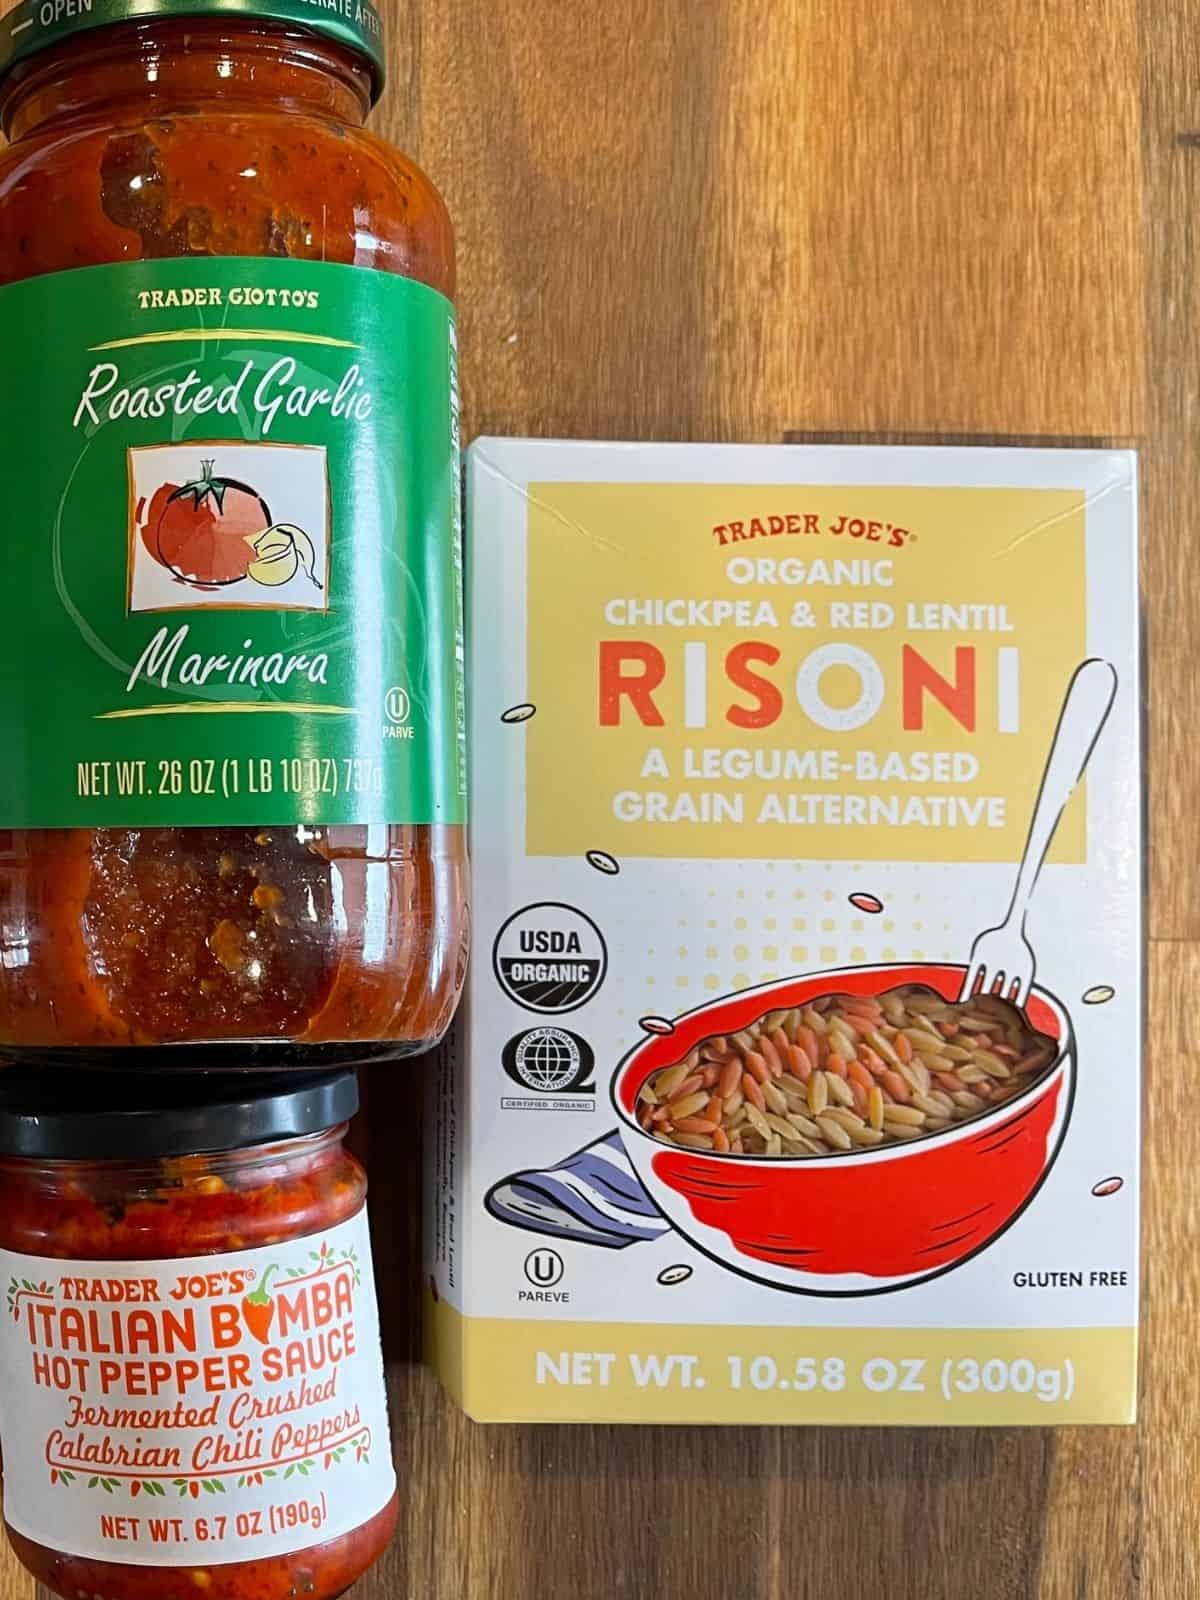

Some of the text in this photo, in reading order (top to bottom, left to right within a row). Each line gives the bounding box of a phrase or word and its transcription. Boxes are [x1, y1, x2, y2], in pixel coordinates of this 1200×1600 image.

[40, 0, 94, 27] OPEN
[138, 287, 320, 309] TRADER GIOTTO'S
[73, 360, 253, 427] Roasted
[254, 357, 373, 434] Garlic
[713, 514, 910, 547] TRADER JOE'S
[726, 558, 894, 586] ORGANIC
[604, 599, 1015, 632] CHICKPEA & RED LENTIL
[126, 624, 328, 693] Marinara
[599, 640, 1020, 734] RISONI
[382, 725, 414, 739] PARVE
[77, 761, 111, 797] NET
[116, 760, 153, 796] WT.
[158, 760, 181, 794] 26
[189, 759, 215, 794] OZ
[222, 760, 239, 798] (1
[249, 759, 272, 793] LB
[641, 748, 979, 783] A LEGUME-BASED
[612, 791, 1006, 828] GRAIN ALTERNATIVE
[519, 930, 582, 954] USDA
[511, 963, 590, 983] ORGANIC
[60, 1269, 246, 1303] TRADER JOE'S
[518, 1289, 570, 1303] PAREVE
[1013, 1271, 1128, 1288] GLUTEN FREE
[27, 1301, 197, 1354] ITALIAN
[32, 1321, 356, 1396] HOT PEPPER SAUCE
[535, 1352, 1075, 1400] NET WT. 10.58 OZ (300g)
[65, 1367, 337, 1430] Fermented Crushed
[46, 1404, 361, 1470] Calabrian Chili Peppers
[101, 1491, 327, 1542] NET WT. 6.7 OZ (190g)
